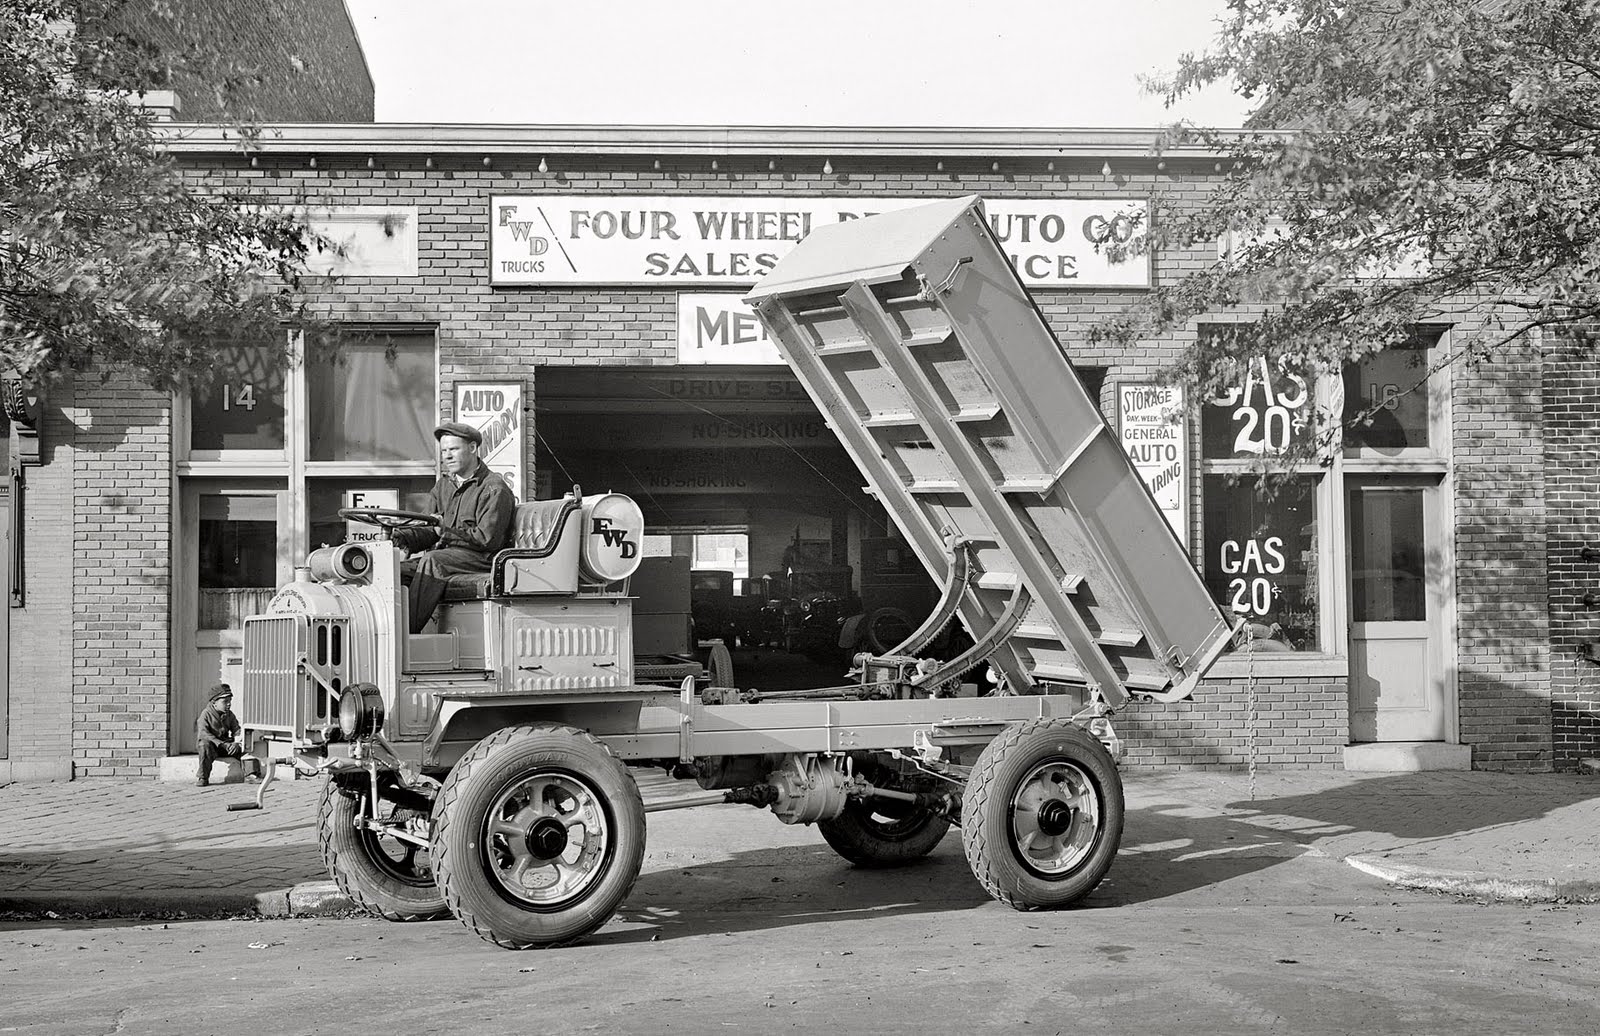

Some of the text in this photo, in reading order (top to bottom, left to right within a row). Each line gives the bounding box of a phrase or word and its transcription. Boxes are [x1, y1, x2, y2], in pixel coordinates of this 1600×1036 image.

[498, 205, 549, 256] FWD
[569, 210, 681, 240] FOUR
[989, 213, 1066, 244] UTO
[500, 260, 545, 273] TRUCKS
[644, 253, 1079, 280] SALES ICE
[695, 306, 769, 349] ME
[223, 384, 256, 411] 14
[461, 390, 504, 412] AUTO
[669, 380, 803, 397] DRIVE SL
[1369, 382, 1399, 410] 16
[1123, 390, 1172, 415] STORAGE
[1125, 428, 1177, 440] GENERAL
[1130, 444, 1177, 463] AUTO
[1152, 461, 1181, 494] IRING
[352, 532, 380, 541] TRUC
[590, 517, 637, 559] FWD
[1220, 536, 1286, 574] GAS
[488, 751, 570, 790] GOODYEAR
